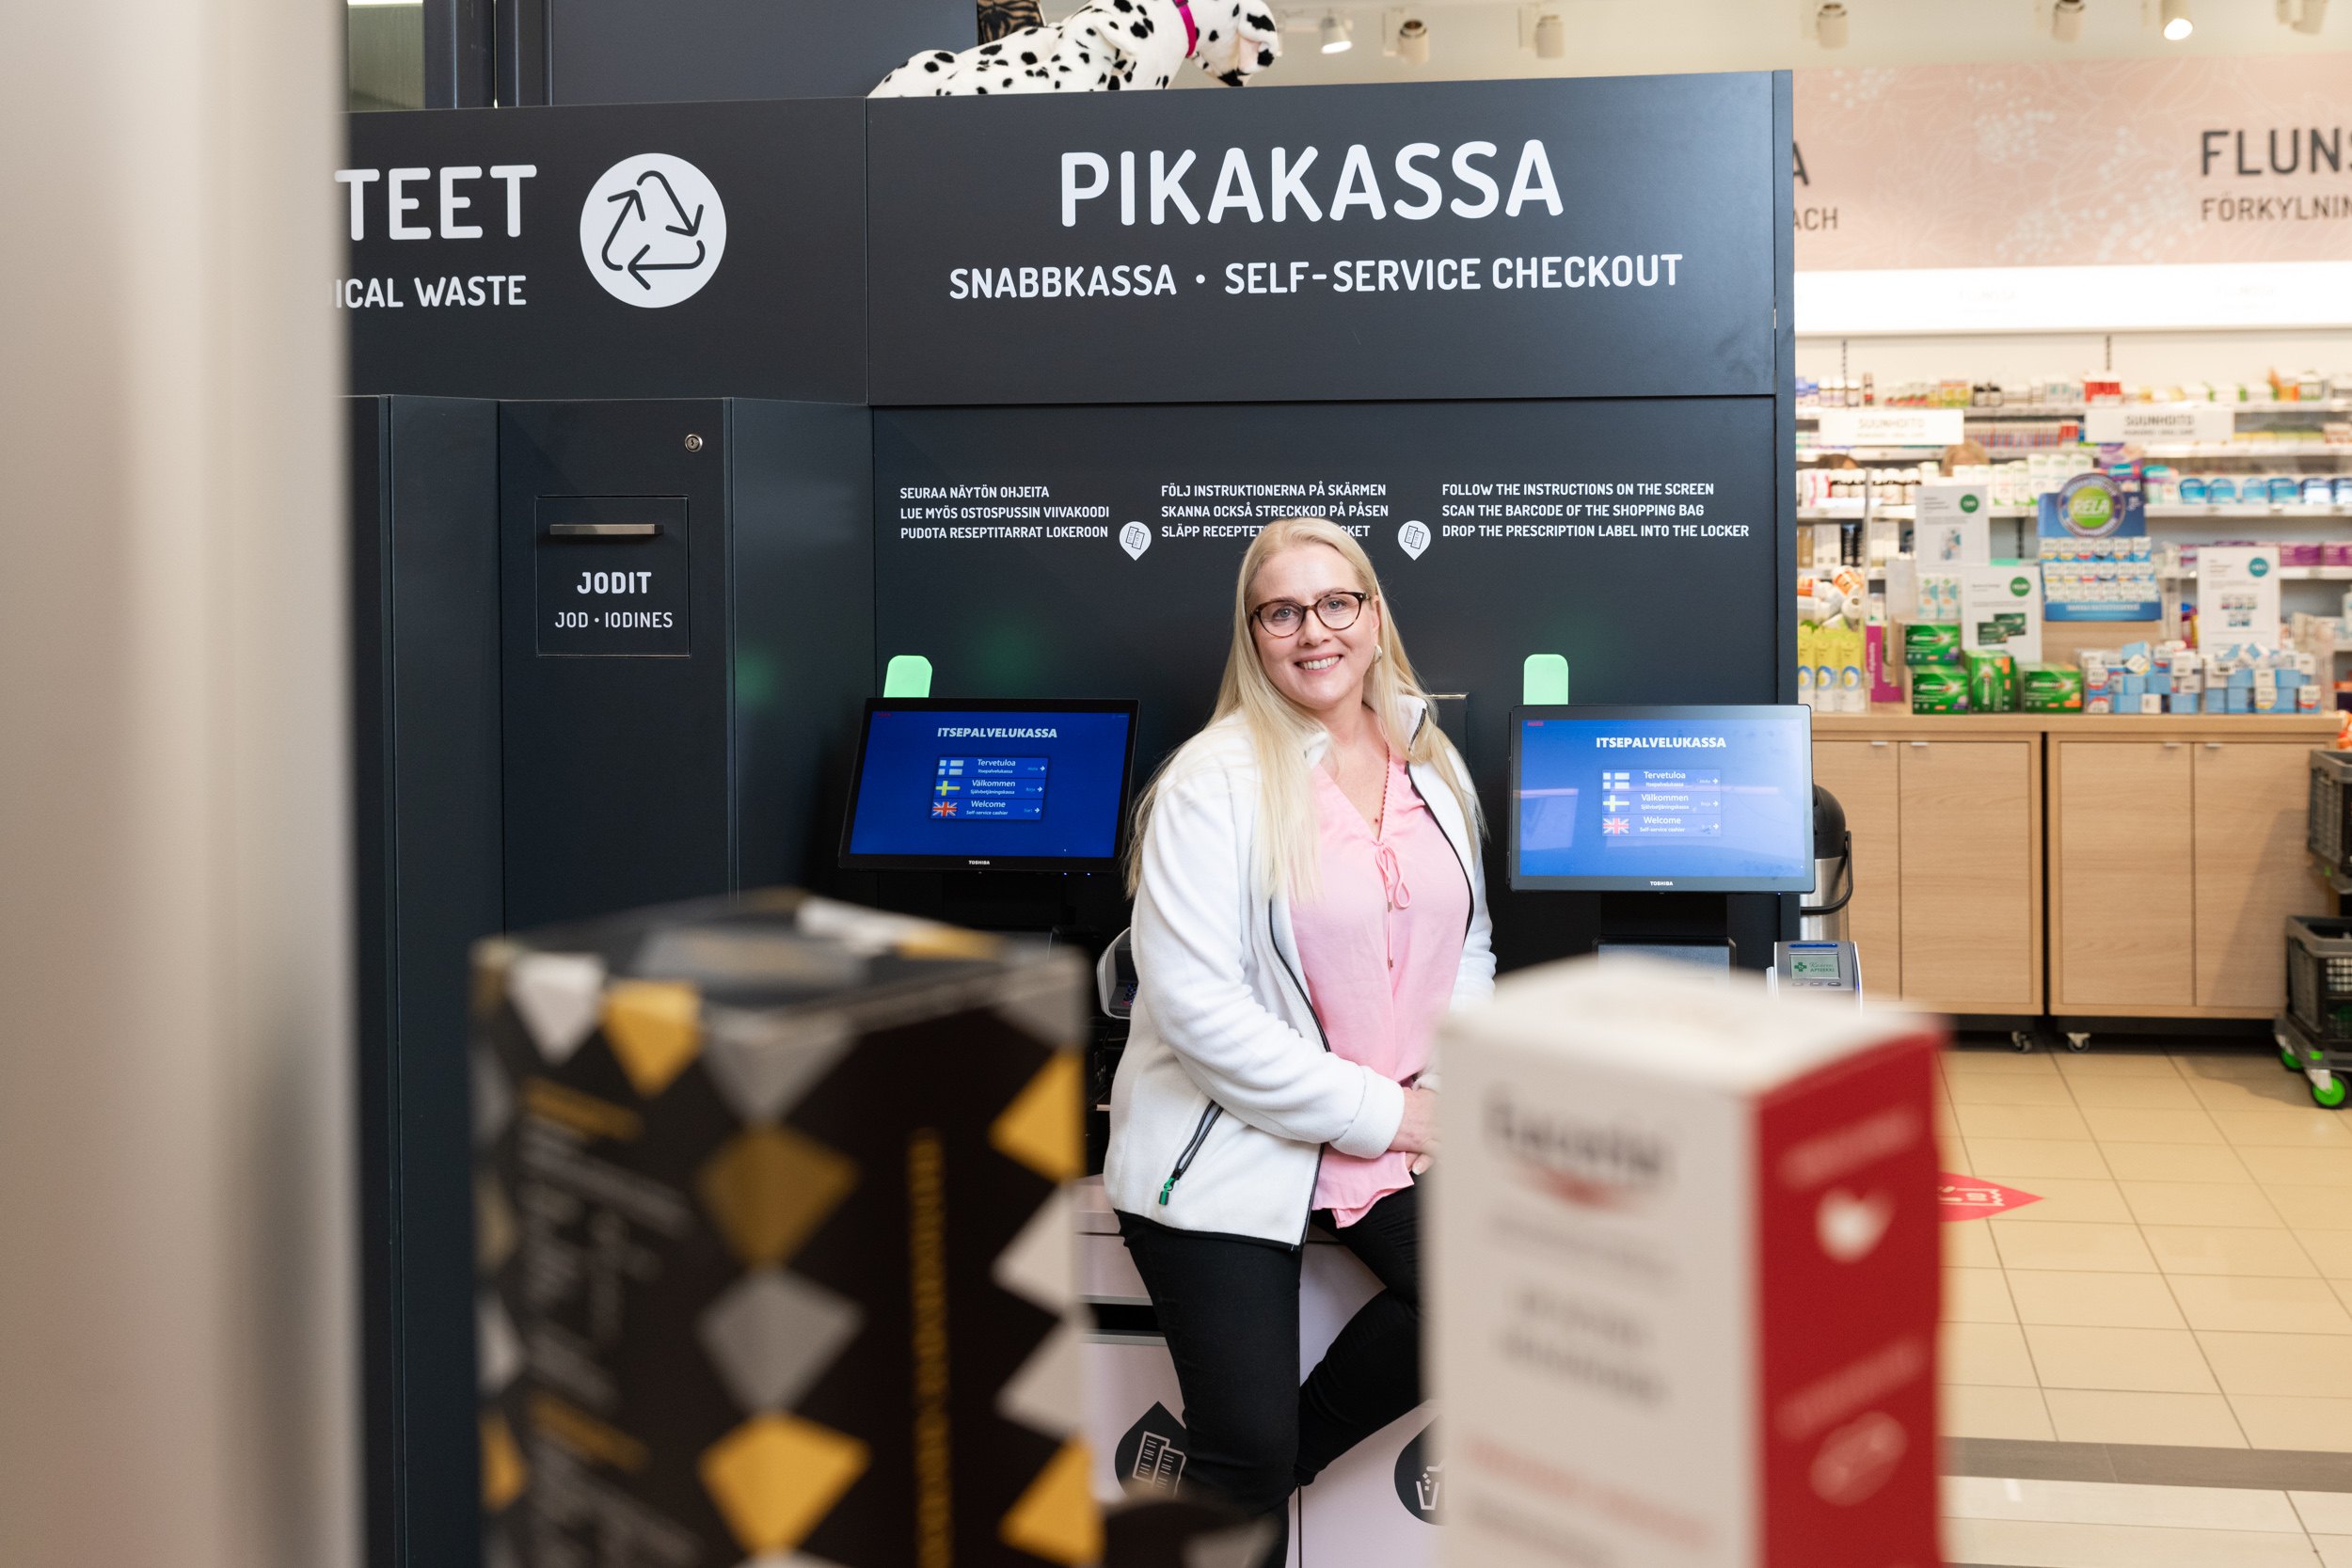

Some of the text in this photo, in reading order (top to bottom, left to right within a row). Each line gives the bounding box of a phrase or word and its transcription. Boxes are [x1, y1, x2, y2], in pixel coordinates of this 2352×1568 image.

[2201, 127, 2352, 176] FLUN
[1061, 138, 1565, 228] PIKAKASSA
[949, 252, 1683, 300] SNABBKASSA SELF-SERVICE CHECKOUT
[414, 275, 527, 308] WASTE
[899, 483, 1050, 499] SEURAA NÄYTÖN OHJEITA
[1161, 481, 1387, 498] FÖLJ INSTRUKTIONERNA PÅ SKÄRMEN
[1442, 483, 1714, 496] FOLLOW THE INSTRUCTIONS ON THE SCREEN
[900, 504, 1110, 519] LUE MYÖS OSTOSPUSSIN VIIVAKOODI
[1161, 500, 1389, 518] SKANNA OCKSÅ STRECKKOD PÅ PÅSEN
[1441, 503, 1705, 517] SCAN THE BARCODE OF THE SHOPPING BAG
[900, 526, 1108, 539] PUDOTA RESEPTITARRAT LOKEROON
[1161, 523, 1200, 538] SLÄPP
[1202, 525, 1267, 537] RECEPTET
[1442, 524, 1750, 537] DROP THE PRESCRIPTION LABEL INTO THE LOCKER
[576, 571, 652, 594] JODIT
[554, 611, 674, 628] JOD IODINES
[937, 727, 1057, 739] ITSEPALVELUKASSA
[1596, 736, 1726, 749] ITSEPALVELUKASSA
[977, 758, 1016, 767] Tervetuloa
[1644, 770, 1686, 779] Tervetuloa
[972, 779, 1016, 787] Välkommen
[971, 800, 1006, 808] Welcome
[1641, 793, 1689, 801] Välkommen
[1643, 816, 1681, 825] Welcome
